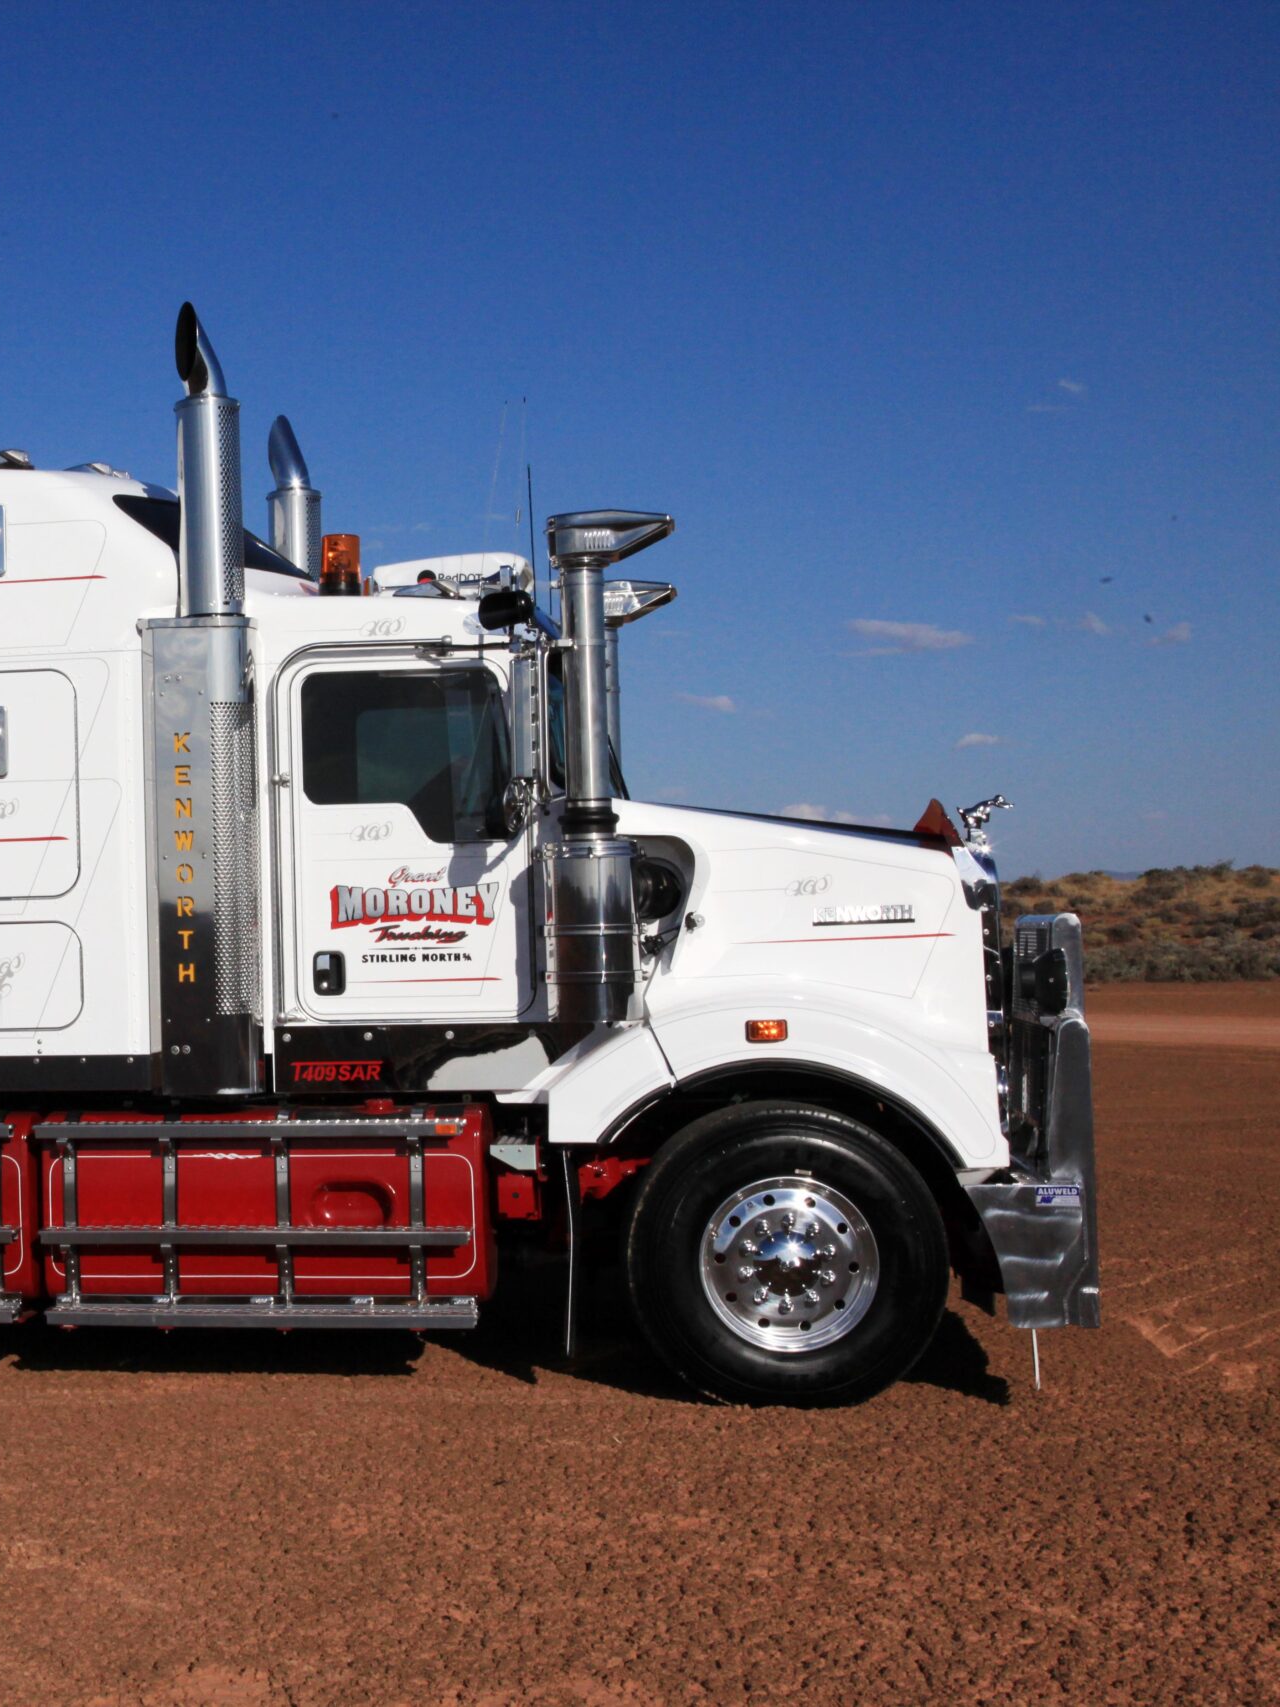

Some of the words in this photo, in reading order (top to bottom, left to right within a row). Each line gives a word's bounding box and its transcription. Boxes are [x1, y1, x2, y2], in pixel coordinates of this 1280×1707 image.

[173, 732, 195, 983] KENWORTH
[388, 865, 447, 888] Grant
[331, 882, 499, 929] MORONEY
[813, 904, 915, 923] KENWORTH
[369, 925, 468, 944] Trucking
[362, 953, 417, 963] STIRLING
[422, 953, 460, 963] NORTH
